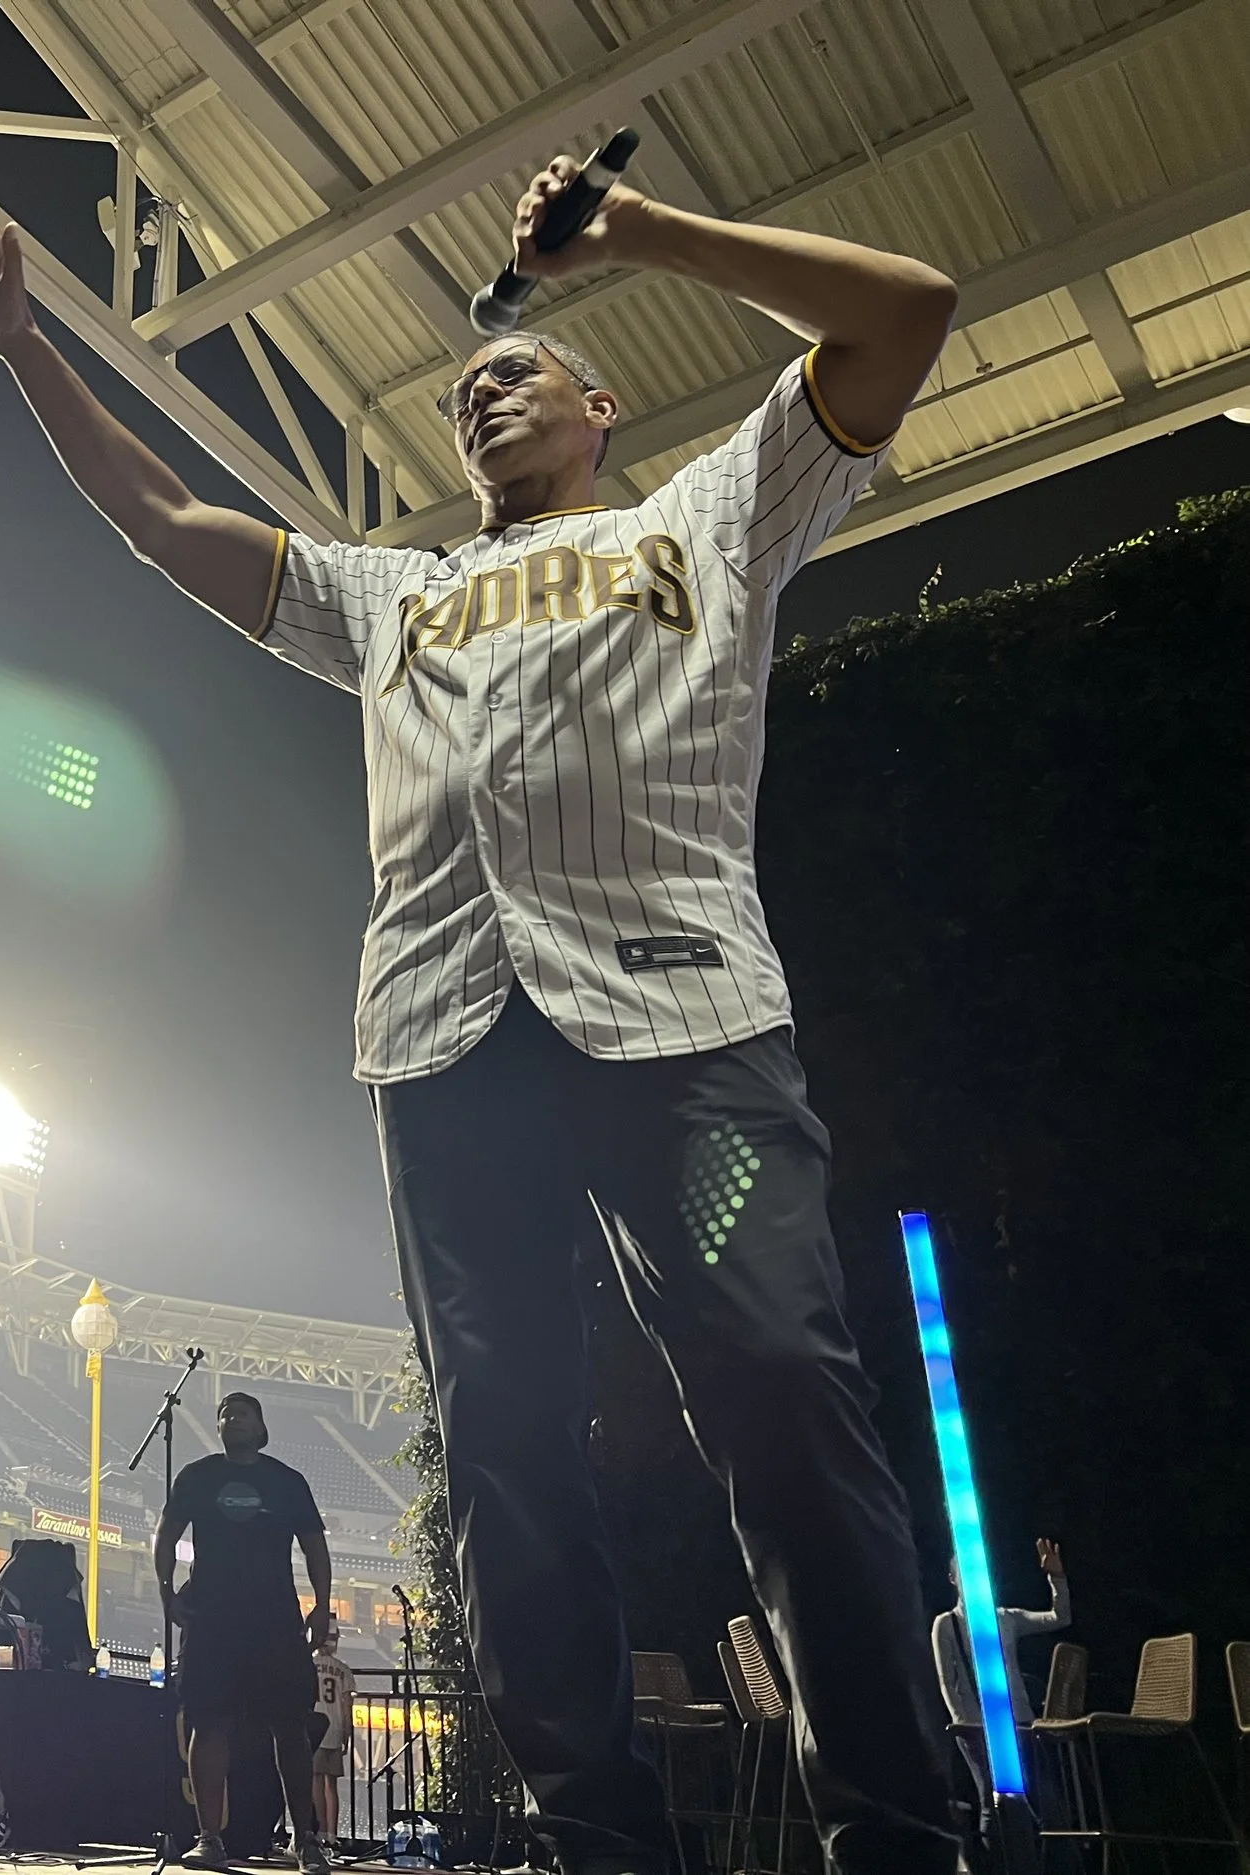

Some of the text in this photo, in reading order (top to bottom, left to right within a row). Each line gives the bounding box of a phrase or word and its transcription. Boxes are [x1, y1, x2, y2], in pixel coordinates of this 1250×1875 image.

[377, 534, 696, 698] PADRES
[35, 1511, 122, 1546] Tarantino SSAGES
